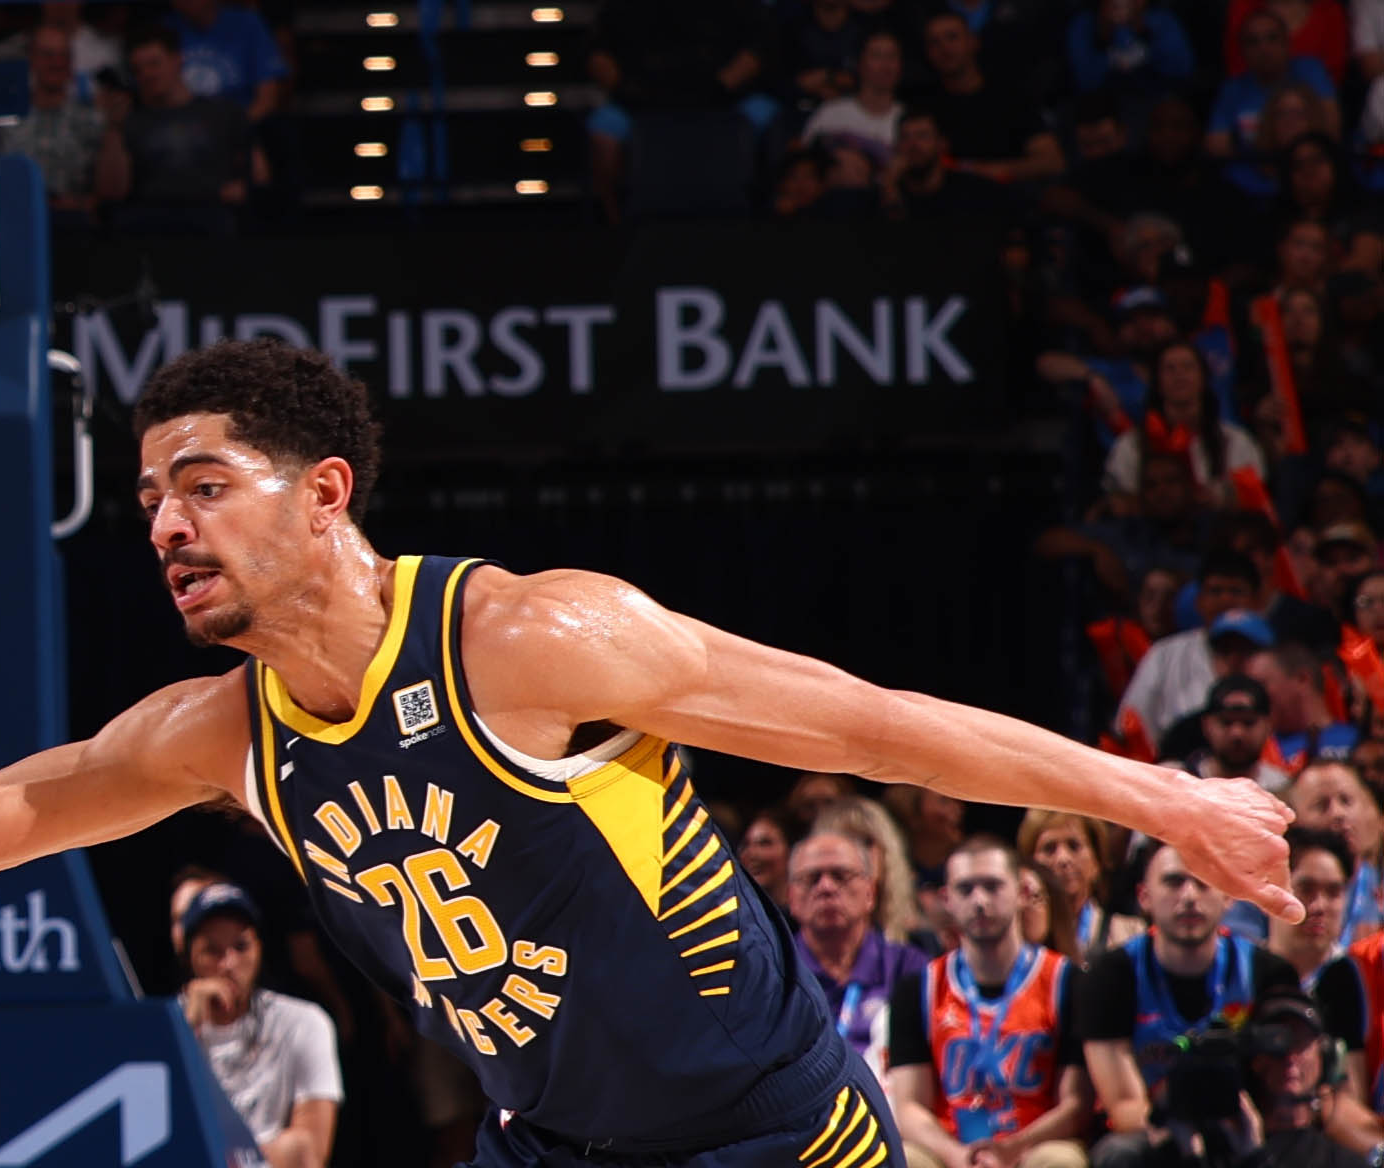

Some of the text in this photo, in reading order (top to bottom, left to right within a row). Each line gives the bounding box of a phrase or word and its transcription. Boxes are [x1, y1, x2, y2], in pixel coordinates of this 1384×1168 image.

[655, 286, 973, 391] BANK
[304, 775, 501, 903] INDIANA
[355, 848, 508, 981] 26
[410, 940, 568, 1055] CERS
